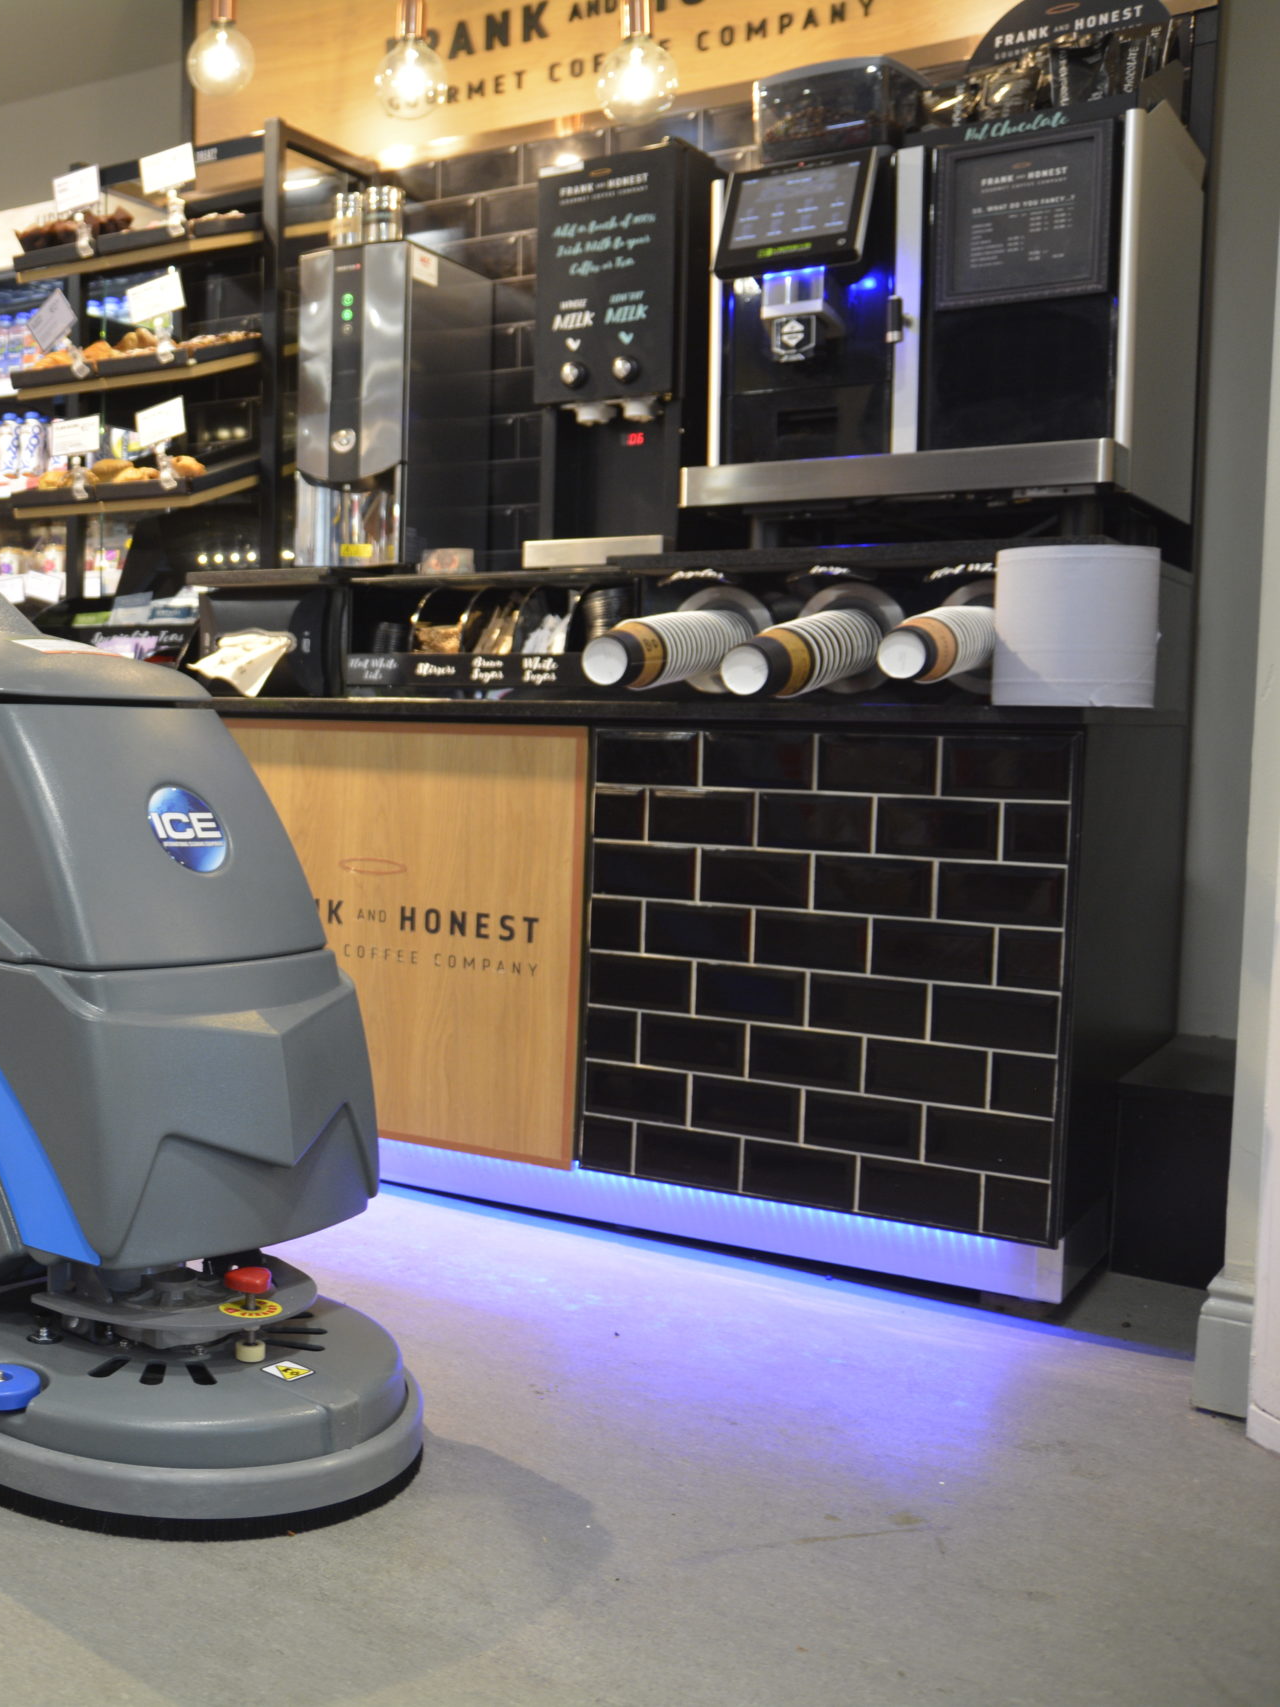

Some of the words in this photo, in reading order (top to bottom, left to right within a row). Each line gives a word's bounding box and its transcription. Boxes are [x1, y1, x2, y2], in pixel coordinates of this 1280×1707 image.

[696, 0, 874, 51] COMPANY
[994, 25, 1049, 49] FRANK
[1053, 23, 1070, 32] AND
[1073, 4, 1144, 31] HONEST
[990, 111, 1070, 137] Chocolate
[559, 183, 594, 197] FRANK
[606, 172, 648, 189] HONEST
[980, 174, 1014, 187] FRANK
[1027, 166, 1068, 180] HONEST
[551, 310, 595, 332] MILK
[604, 303, 649, 326] MILK
[522, 656, 559, 671] White
[150, 812, 222, 839] ICE
[357, 908, 387, 924] AND
[399, 905, 540, 944] HONEST
[343, 944, 418, 965] COFFEE
[433, 953, 539, 977] COMPANY
